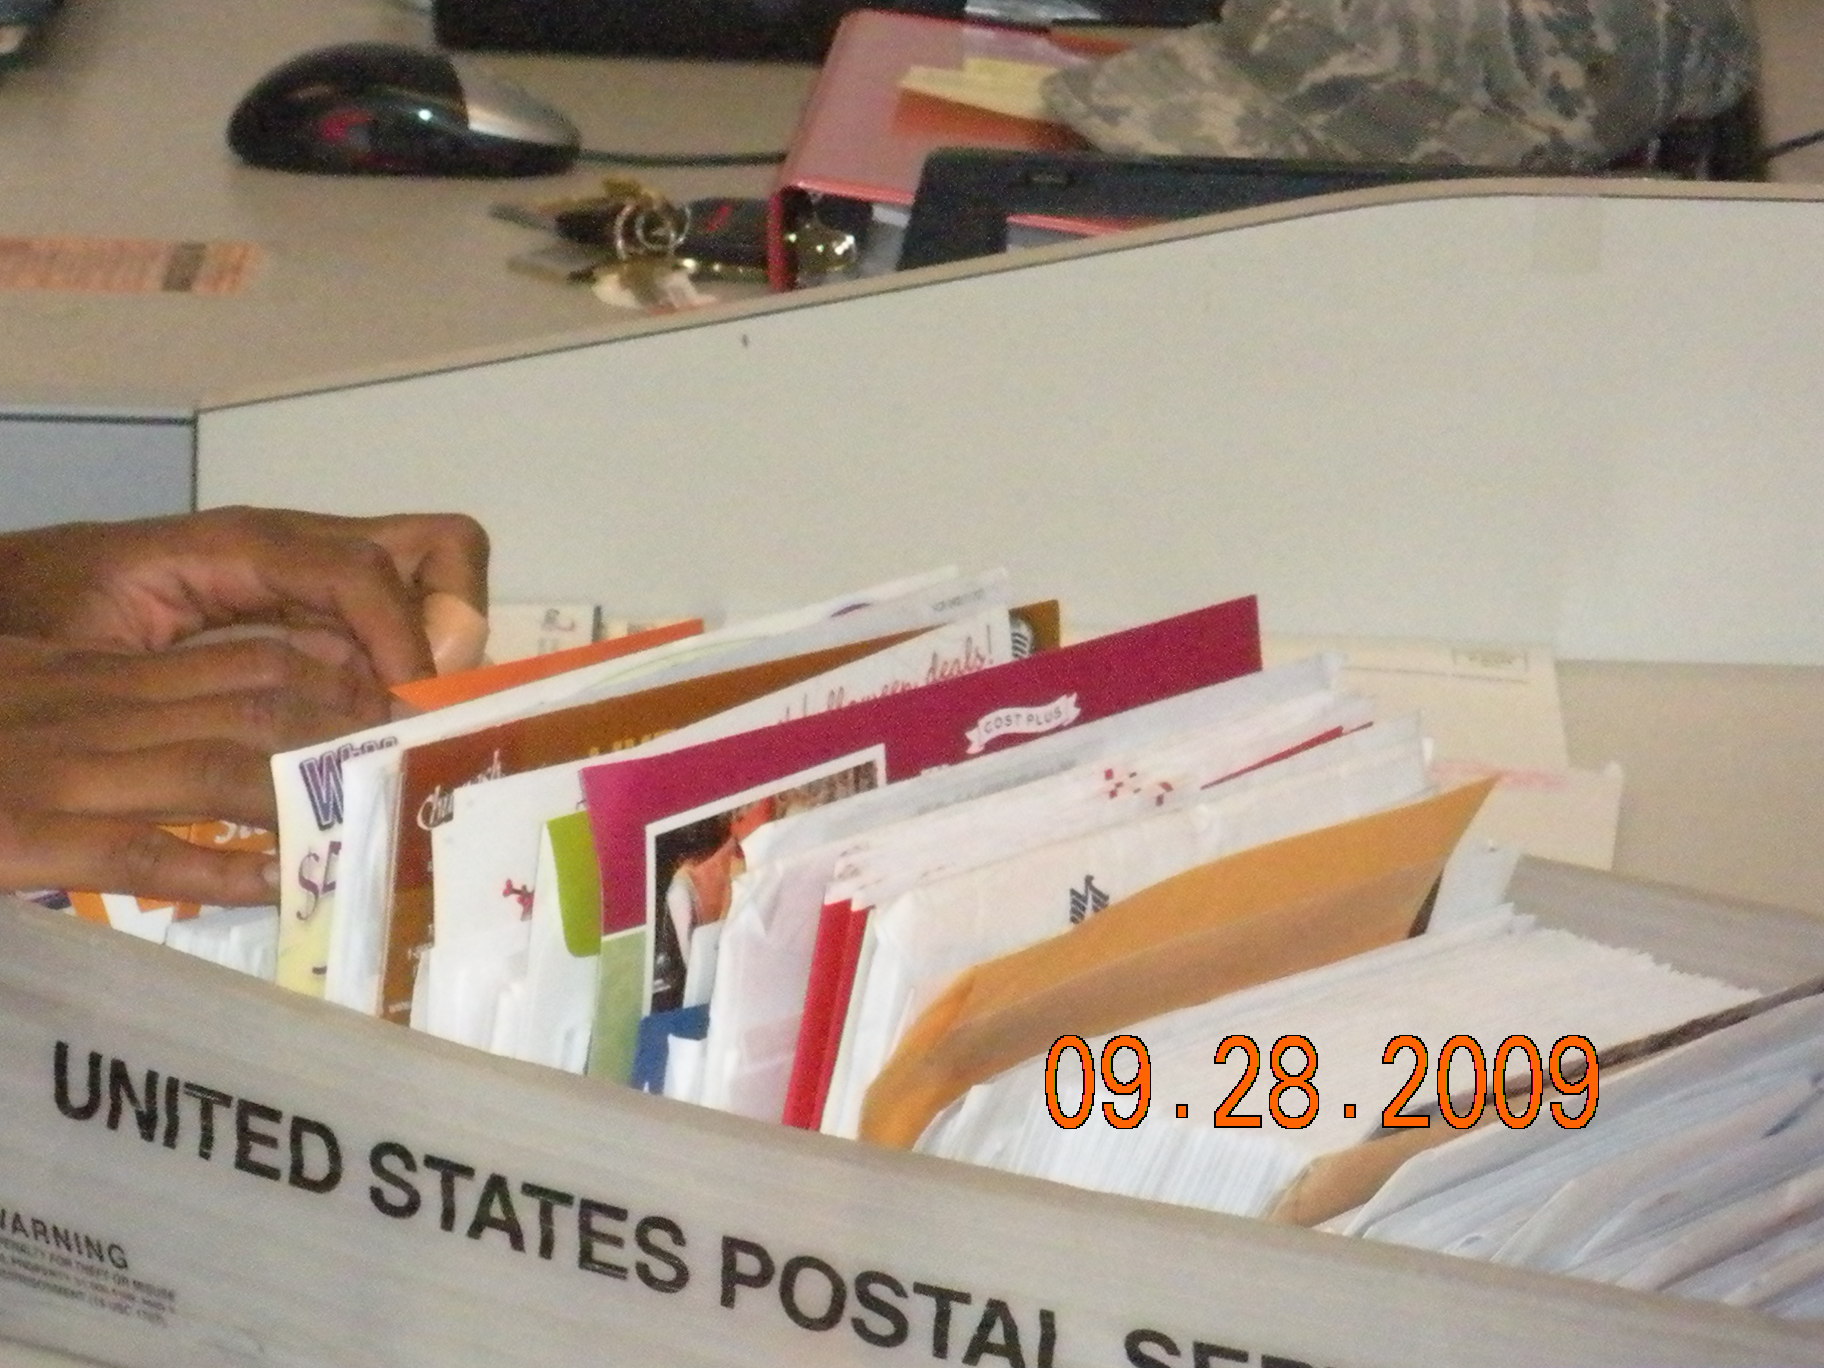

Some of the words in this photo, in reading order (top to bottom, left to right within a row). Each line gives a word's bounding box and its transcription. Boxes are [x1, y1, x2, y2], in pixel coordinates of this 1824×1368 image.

[983, 713, 1024, 734] COST
[1026, 705, 1063, 726] PLUS
[54, 1041, 342, 1194] UNITED
[369, 1142, 690, 1295] STATES
